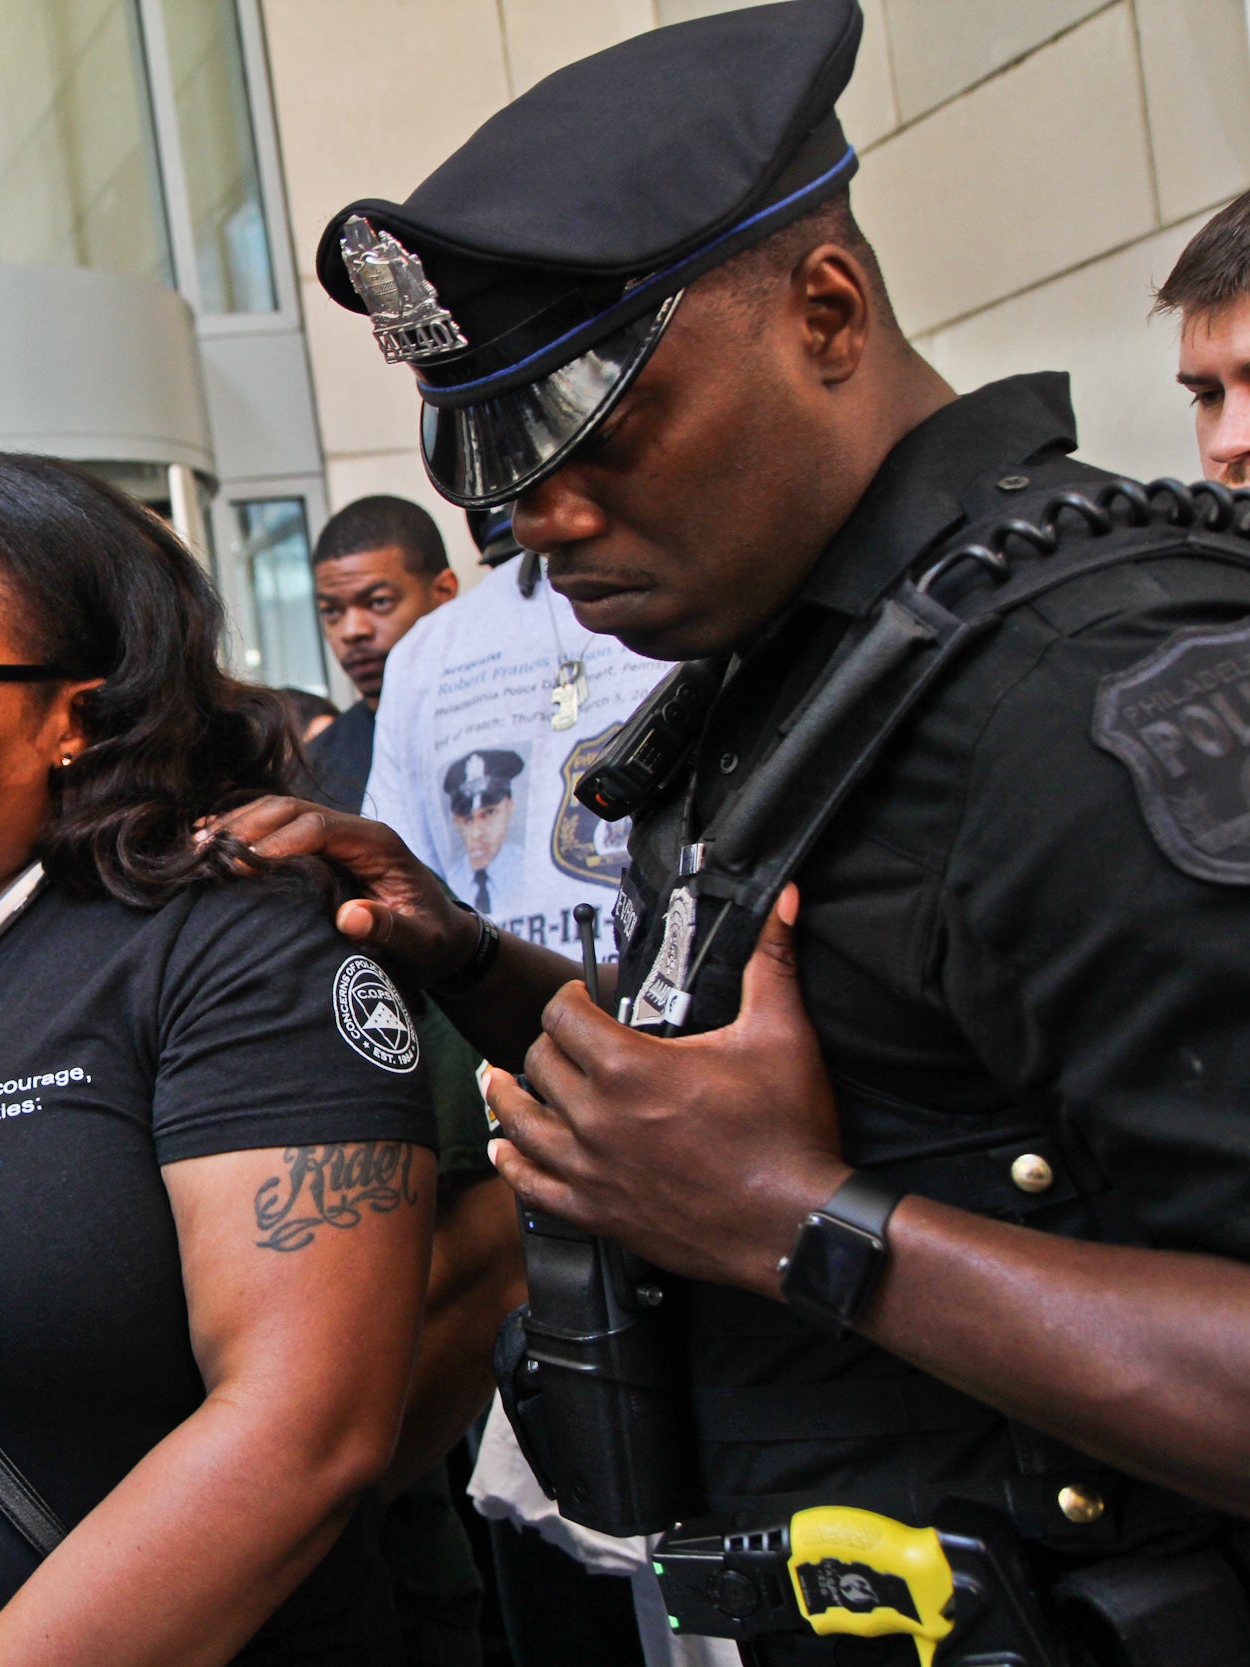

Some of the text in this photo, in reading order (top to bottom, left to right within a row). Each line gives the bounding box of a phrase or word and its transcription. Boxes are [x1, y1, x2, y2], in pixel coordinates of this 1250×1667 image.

[1123, 655, 1250, 726] PHILADEL
[1139, 681, 1250, 779] POL
[346, 962, 356, 976] OF
[338, 975, 361, 1040] CONCERNS
[372, 1046, 397, 1065] EST.
